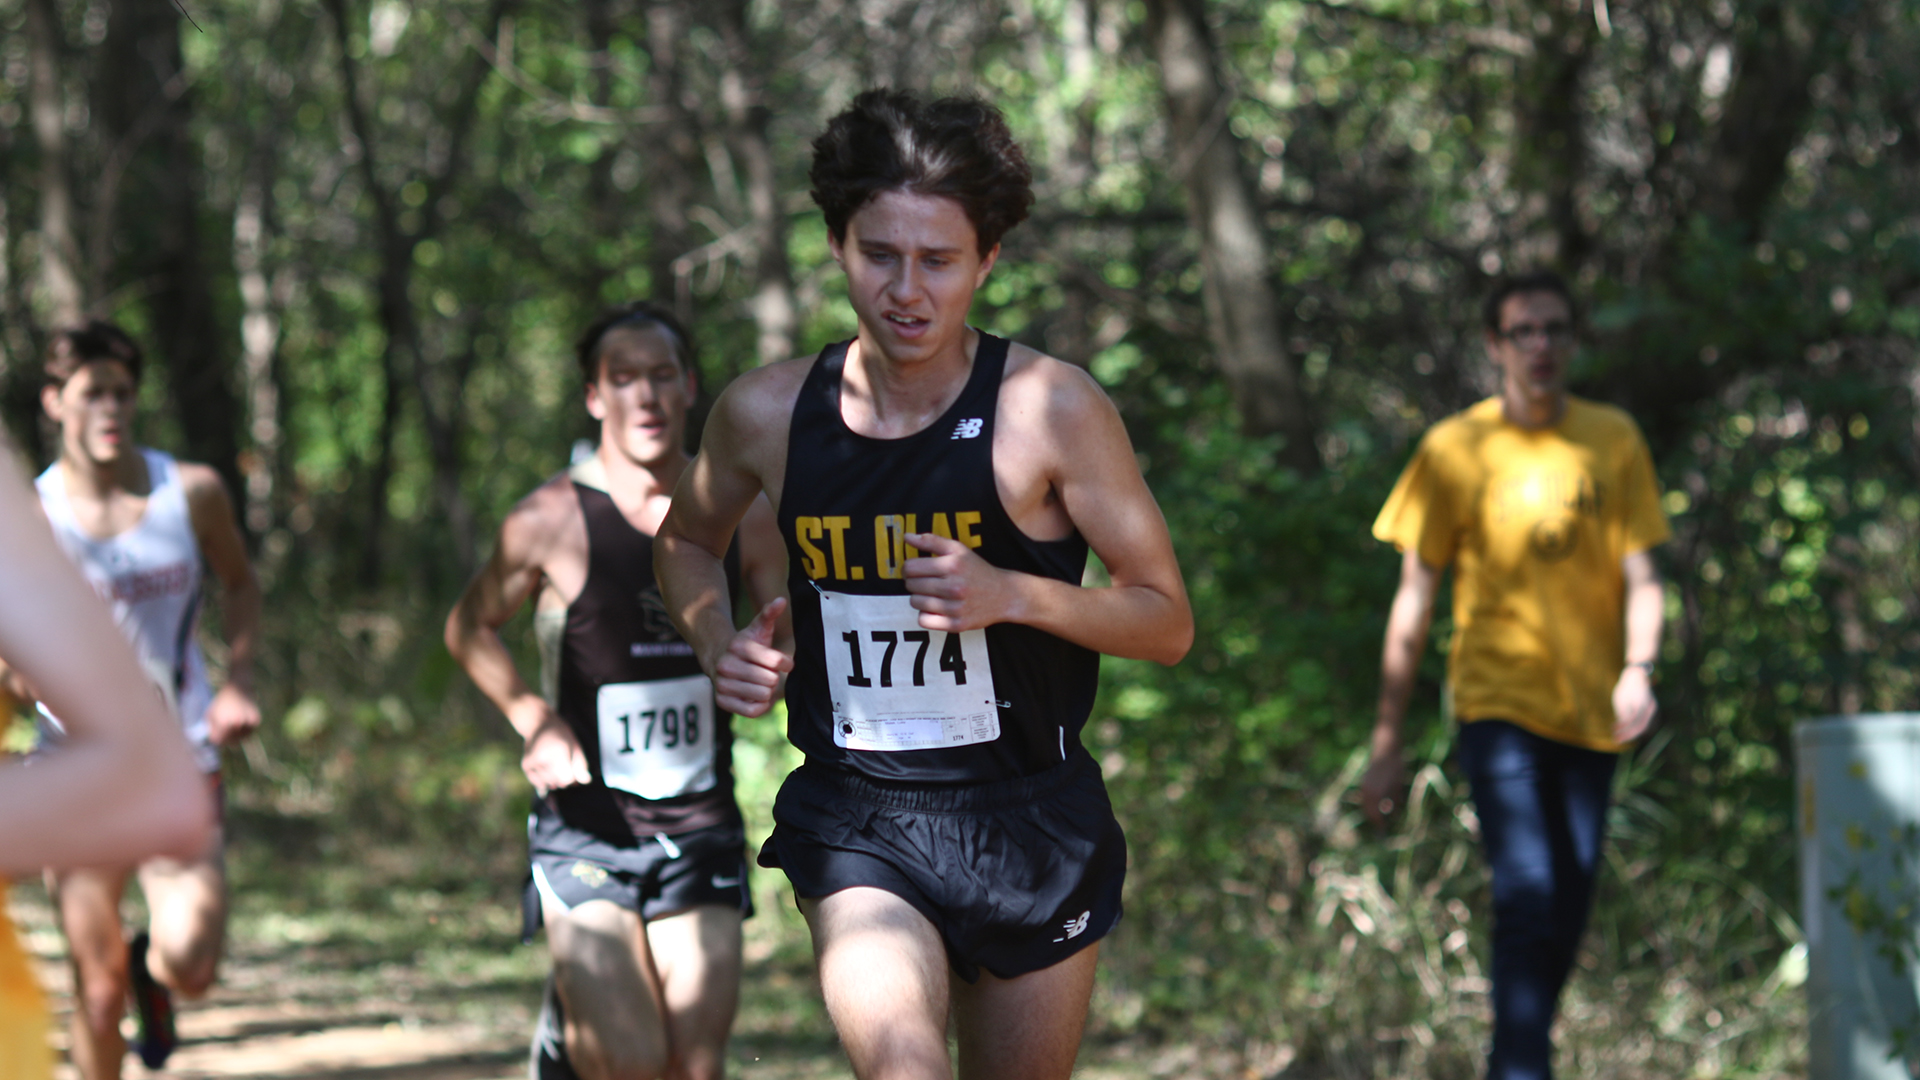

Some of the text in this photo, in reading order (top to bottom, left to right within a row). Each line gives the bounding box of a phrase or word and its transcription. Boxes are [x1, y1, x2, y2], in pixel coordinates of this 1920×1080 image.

[796, 516, 864, 580] ST.
[842, 630, 967, 688] 1774
[616, 703, 700, 754] 1798
